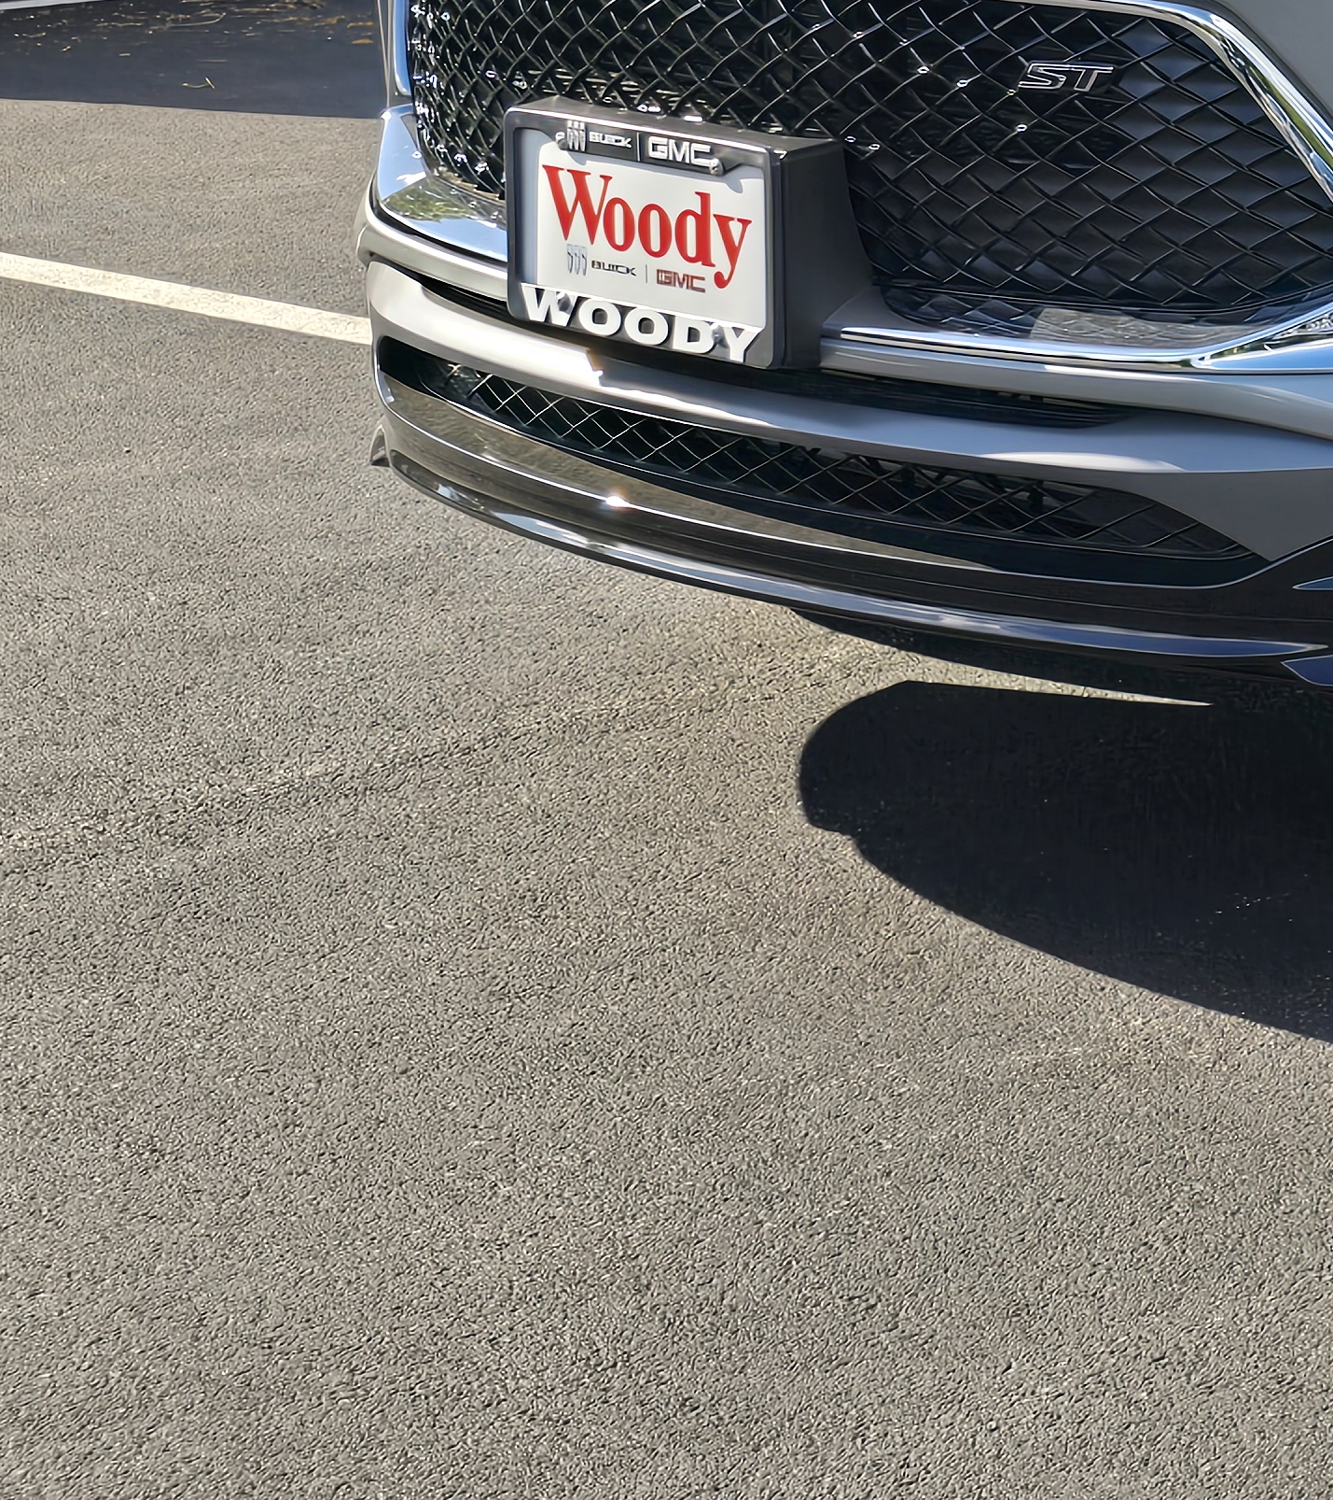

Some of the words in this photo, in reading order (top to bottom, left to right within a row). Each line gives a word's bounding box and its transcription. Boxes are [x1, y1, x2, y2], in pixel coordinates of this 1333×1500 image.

[1018, 63, 1114, 92] ST
[588, 131, 632, 149] BUICK
[648, 135, 713, 169] GMC
[543, 164, 752, 289] Woody
[591, 259, 637, 277] BUICK
[656, 268, 706, 293] GMC
[521, 283, 762, 363] WOODY
